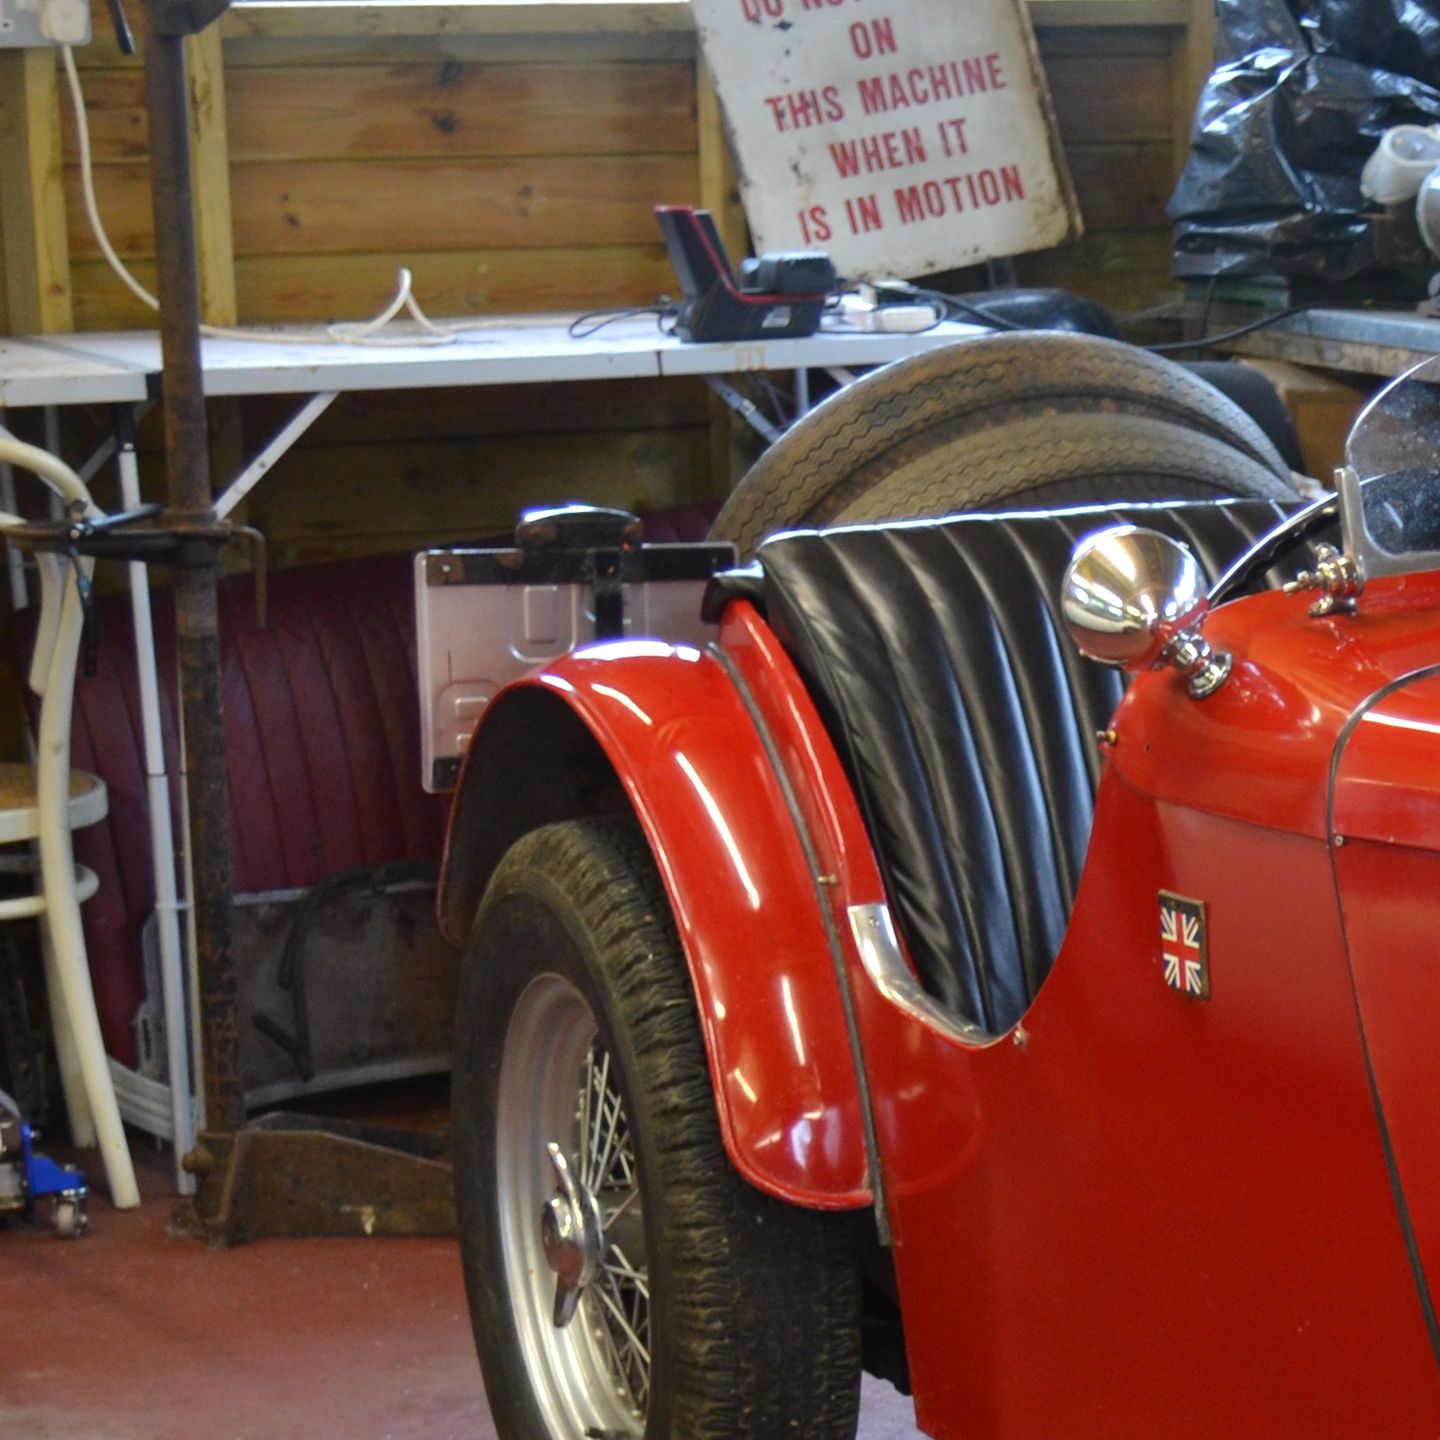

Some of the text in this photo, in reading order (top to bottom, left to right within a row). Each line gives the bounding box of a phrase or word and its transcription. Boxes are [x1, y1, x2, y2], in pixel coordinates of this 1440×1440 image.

[848, 17, 897, 60] ON
[764, 53, 1007, 133] THIS MACHINE
[829, 117, 969, 179] WHEN IT
[797, 164, 1025, 245] IS IN MOTION
